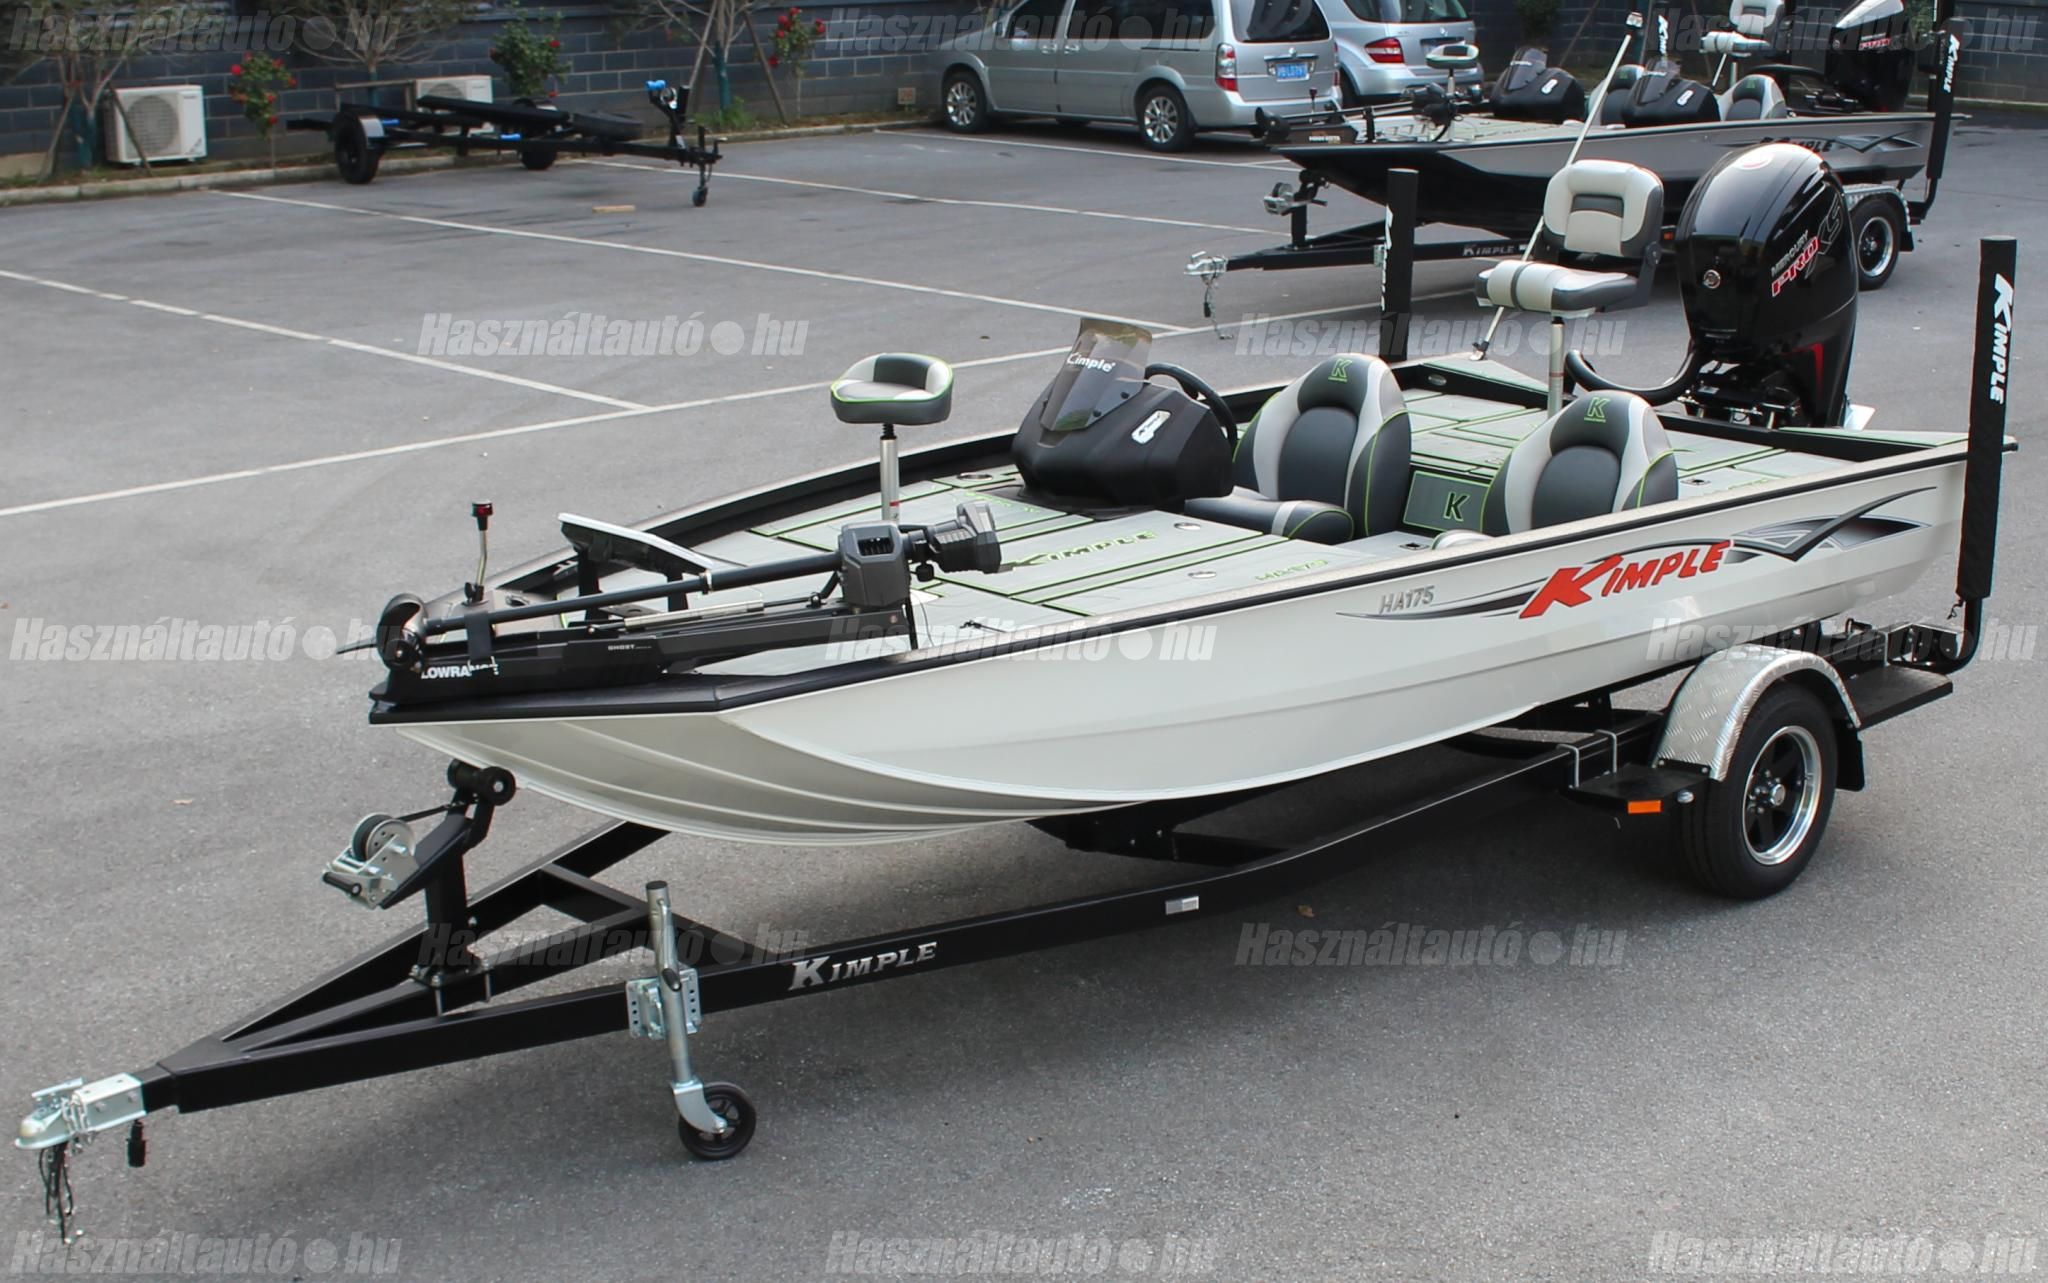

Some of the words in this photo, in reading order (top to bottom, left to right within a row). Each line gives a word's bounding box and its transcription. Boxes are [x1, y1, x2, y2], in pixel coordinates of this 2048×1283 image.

[1943, 33, 1961, 94] KIMPLE
[1462, 244, 1515, 257] KIMPLE
[1771, 229, 1810, 276] MERCURY
[1771, 236, 1819, 298] PRO
[1988, 273, 2015, 404] KIMPLE
[1443, 492, 1470, 522] K
[1379, 585, 1435, 613] HA175
[1519, 539, 1732, 618] KIMPLE
[788, 941, 938, 991] KIMPLE
